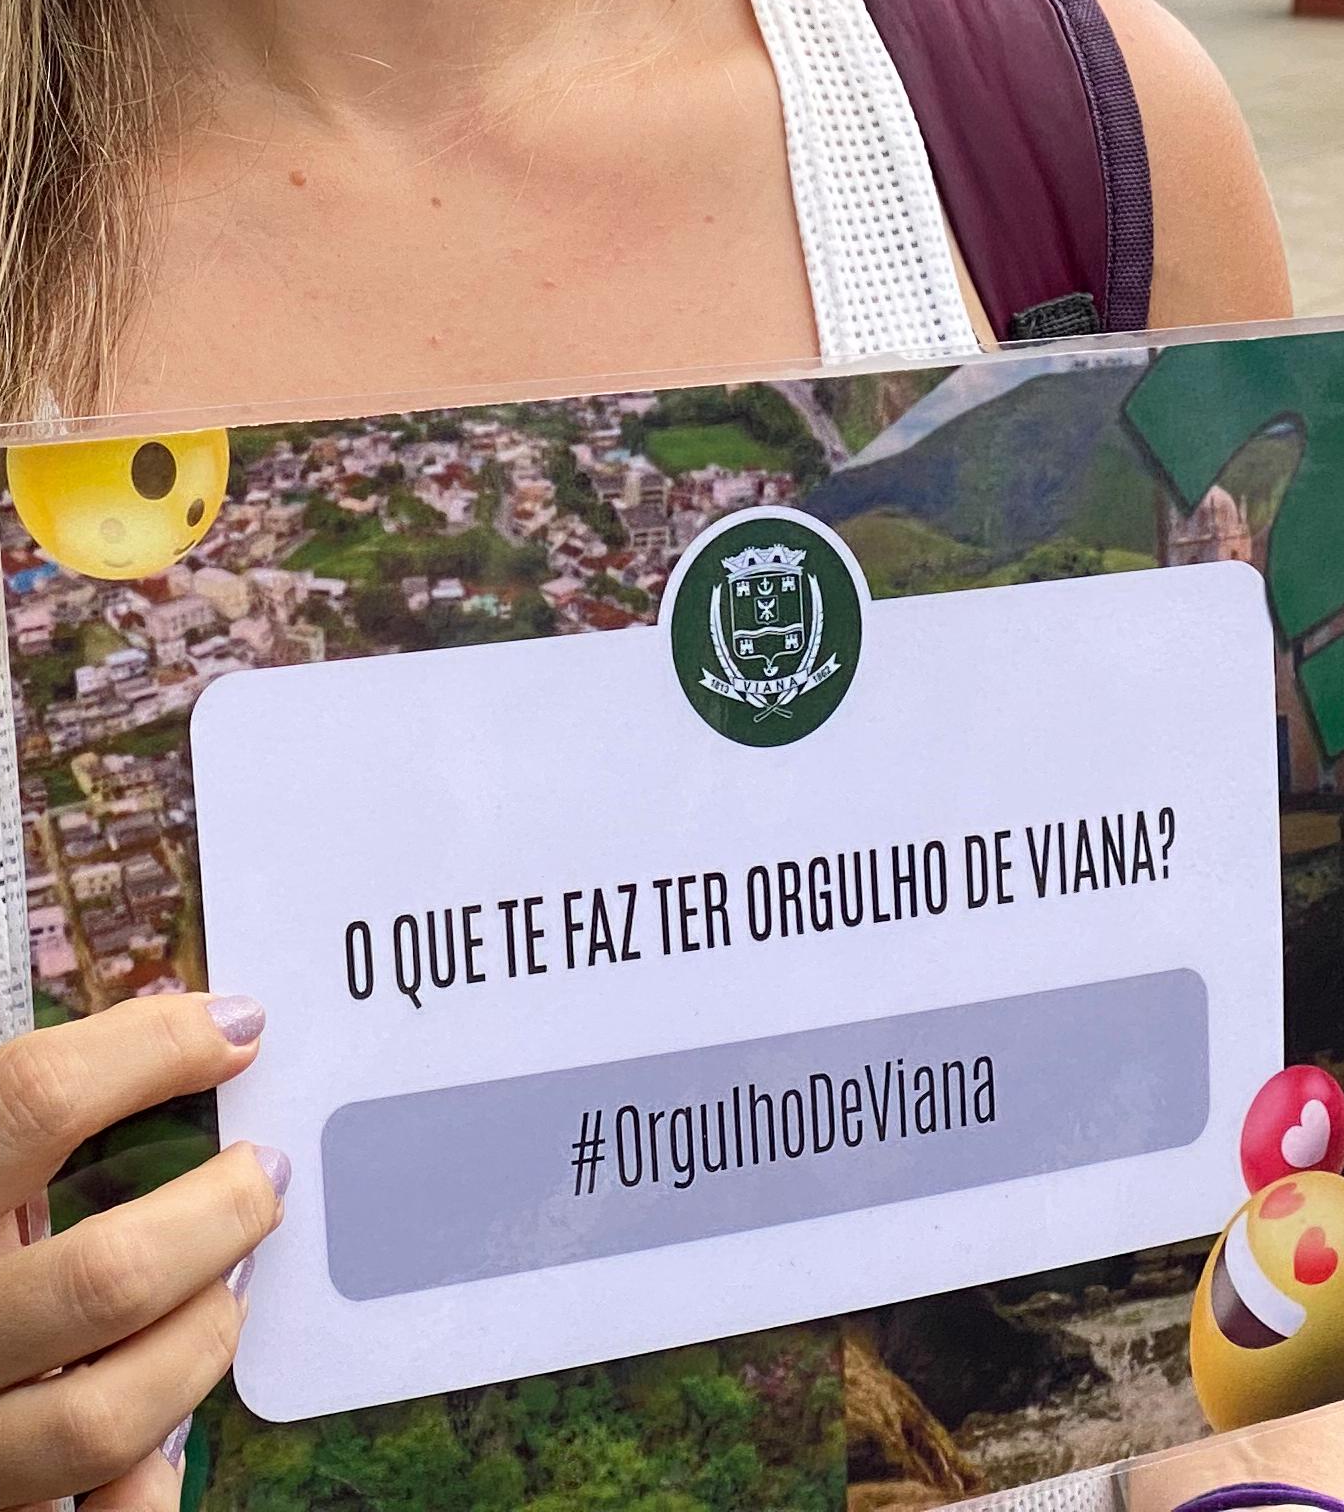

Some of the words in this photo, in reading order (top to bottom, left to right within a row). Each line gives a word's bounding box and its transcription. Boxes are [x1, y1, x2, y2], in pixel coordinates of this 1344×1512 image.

[743, 676, 798, 693] VIANA
[345, 920, 374, 1000] O
[393, 904, 486, 1010] QUE
[497, 896, 548, 978] TE
[563, 883, 641, 970] FAZ
[652, 872, 732, 956] TER
[746, 840, 948, 942] ORGULHO
[964, 830, 1014, 910] DE
[1025, 806, 1176, 899] VIANA?
[570, 1055, 996, 1197] #OrgulhoDeViana
